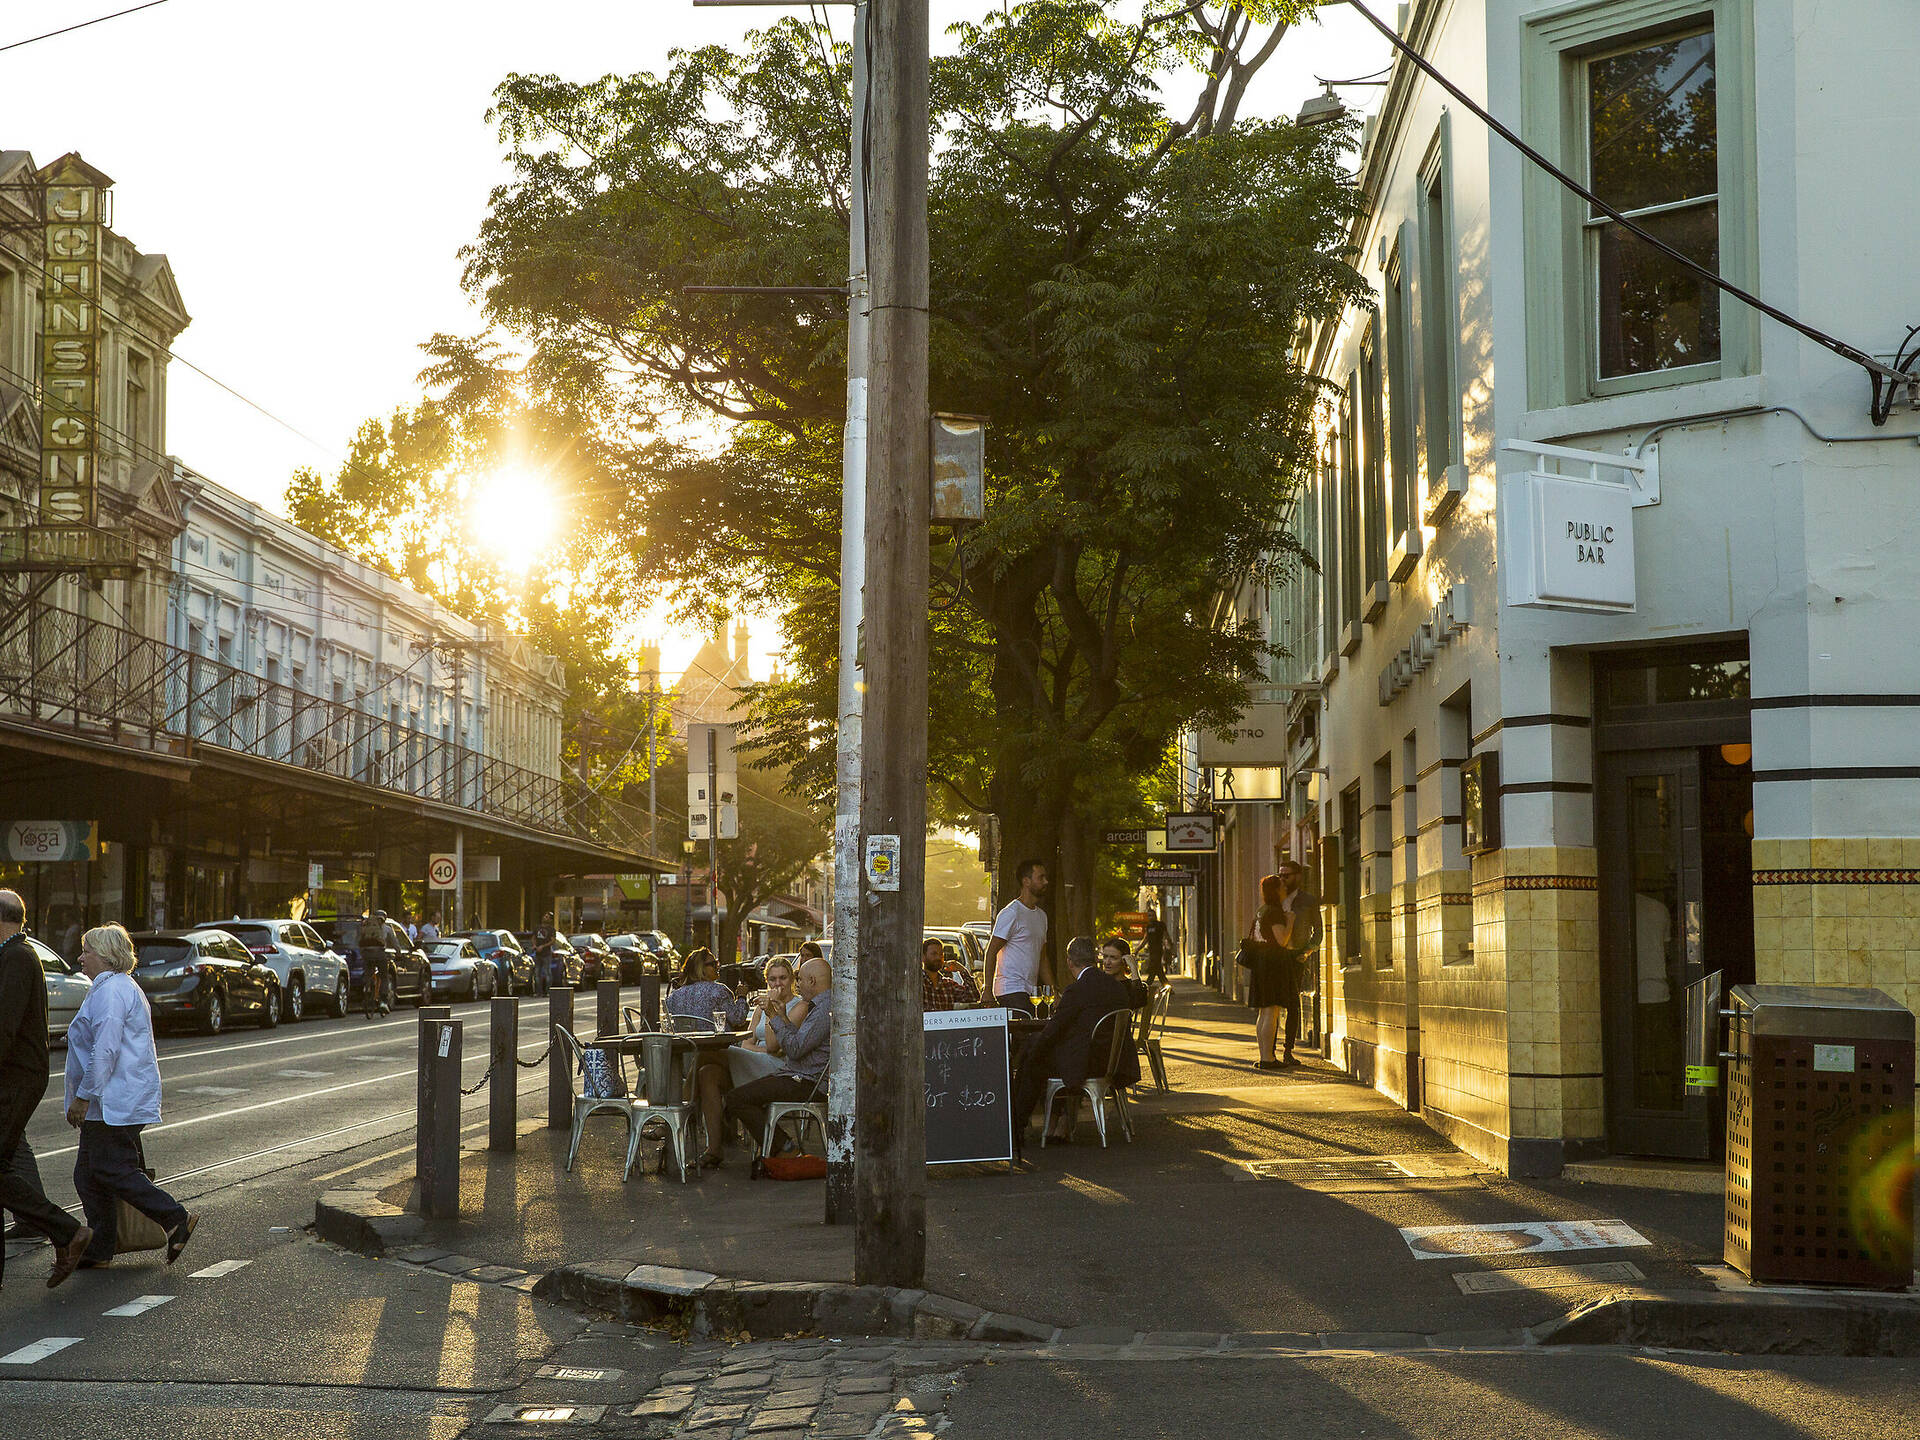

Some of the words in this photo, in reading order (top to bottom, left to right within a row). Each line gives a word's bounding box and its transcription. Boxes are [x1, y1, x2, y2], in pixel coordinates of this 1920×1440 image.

[51, 189, 88, 522] JOHNSTONS
[1566, 520, 1614, 544] PUBLIC
[1576, 545, 1605, 564] BAR
[1233, 728, 1264, 739] STRO
[14, 825, 60, 853] Yoga
[1106, 829, 1147, 842] arcadi
[434, 865, 453, 878] 40
[620, 873, 651, 881] SELLIN
[924, 1018, 943, 1027] DERS
[948, 1016, 971, 1025] ARMS
[976, 1013, 1004, 1023] HOTEL
[958, 1084, 996, 1111] $20
